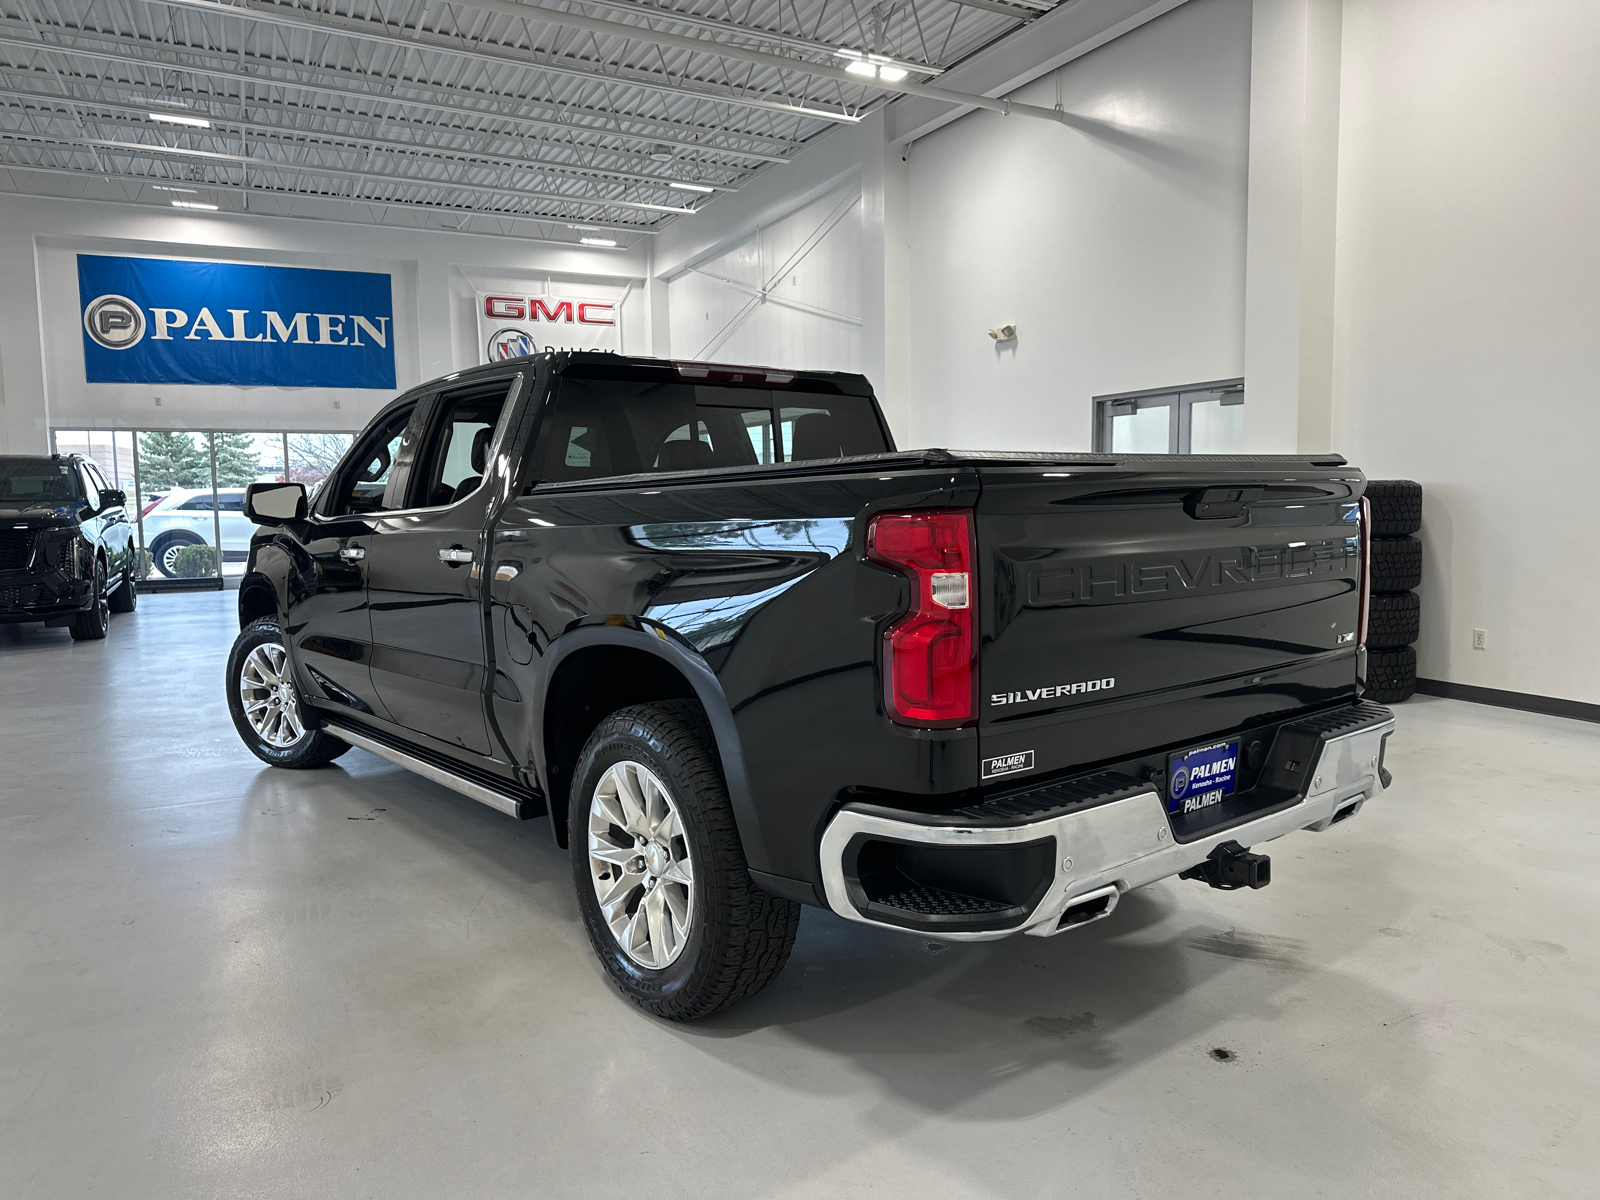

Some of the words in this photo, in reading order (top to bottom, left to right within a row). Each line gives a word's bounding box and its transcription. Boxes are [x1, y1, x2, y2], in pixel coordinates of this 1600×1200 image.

[484, 294, 616, 327] GMC
[148, 307, 390, 349] PALMEN
[1028, 540, 1356, 605] CHEVROLET
[990, 677, 1115, 706] SILVERADO
[990, 754, 1026, 770] PALMEN
[1188, 742, 1227, 757] palmen.com
[1189, 756, 1237, 781] PALMEN
[1191, 779, 1213, 790] Kenosha
[1215, 774, 1232, 784] Racine
[1183, 789, 1224, 814] PALMEN
